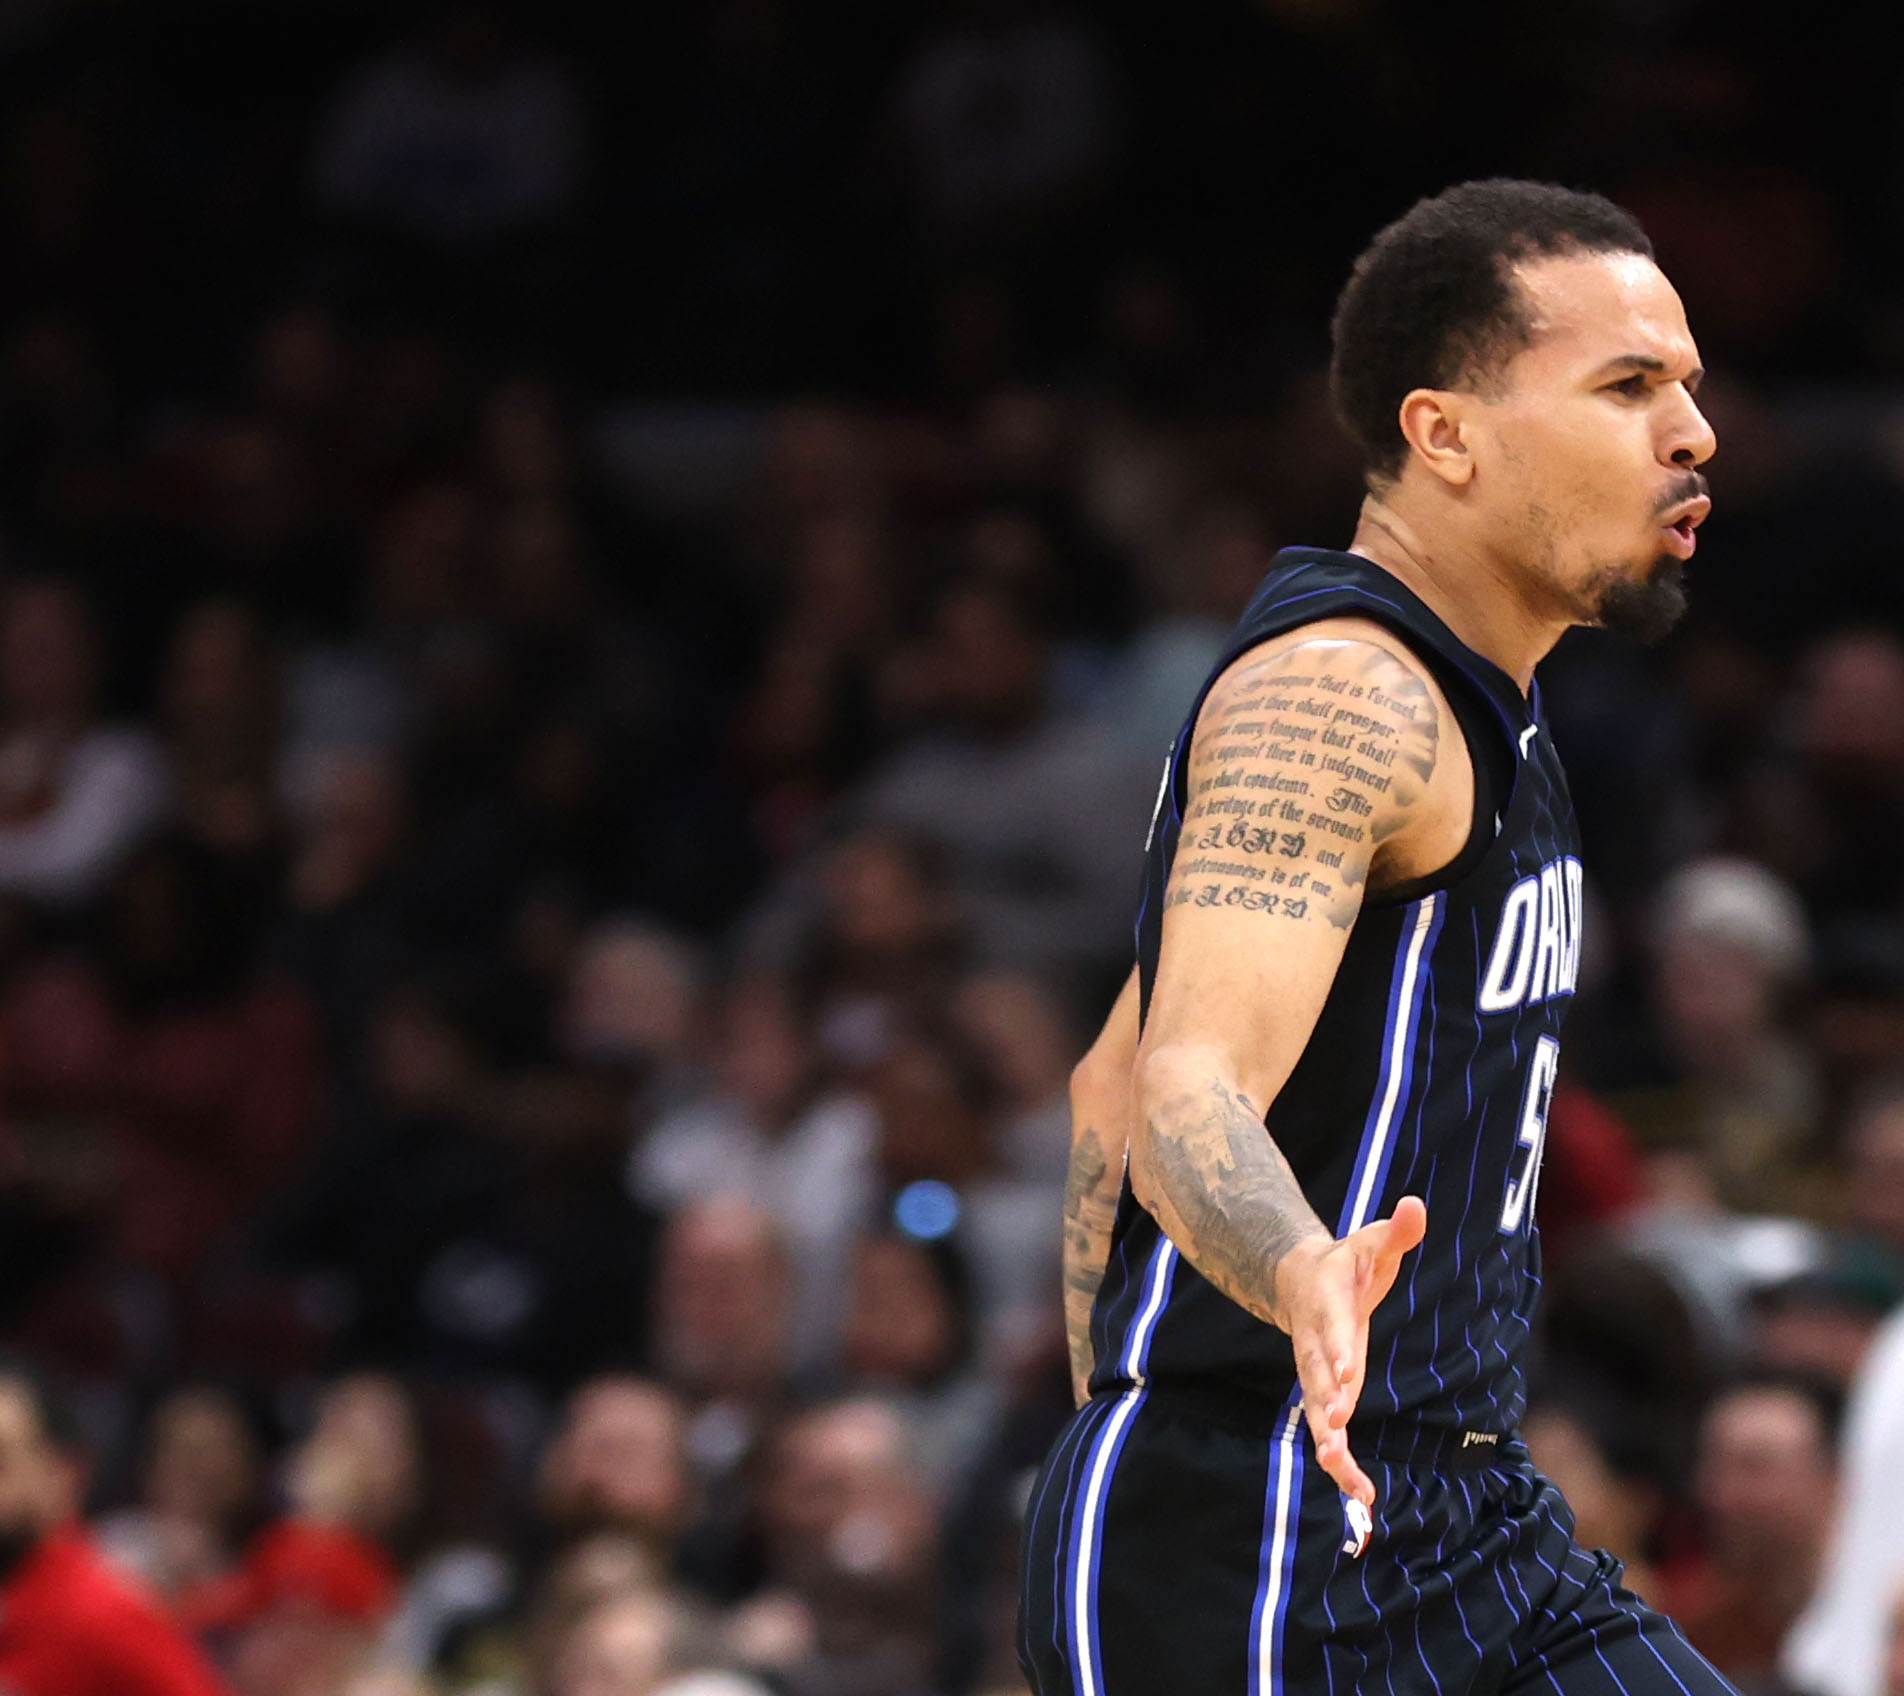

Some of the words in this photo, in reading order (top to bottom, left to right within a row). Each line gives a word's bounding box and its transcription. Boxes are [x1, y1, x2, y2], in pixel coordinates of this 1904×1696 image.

[1318, 673, 1348, 695] that
[1349, 682, 1364, 698] is
[1321, 725, 1356, 750] that
[1356, 738, 1399, 768] shall
[1265, 742, 1295, 763] thee
[1299, 749, 1316, 767] in
[1317, 753, 1393, 794] judgment
[1259, 798, 1280, 817] of
[1279, 799, 1303, 823] the
[1324, 787, 1374, 818] This
[1316, 849, 1345, 869] and
[1271, 867, 1286, 885] is
[1289, 872, 1310, 890] of
[1498, 1033, 1560, 1236] 5
